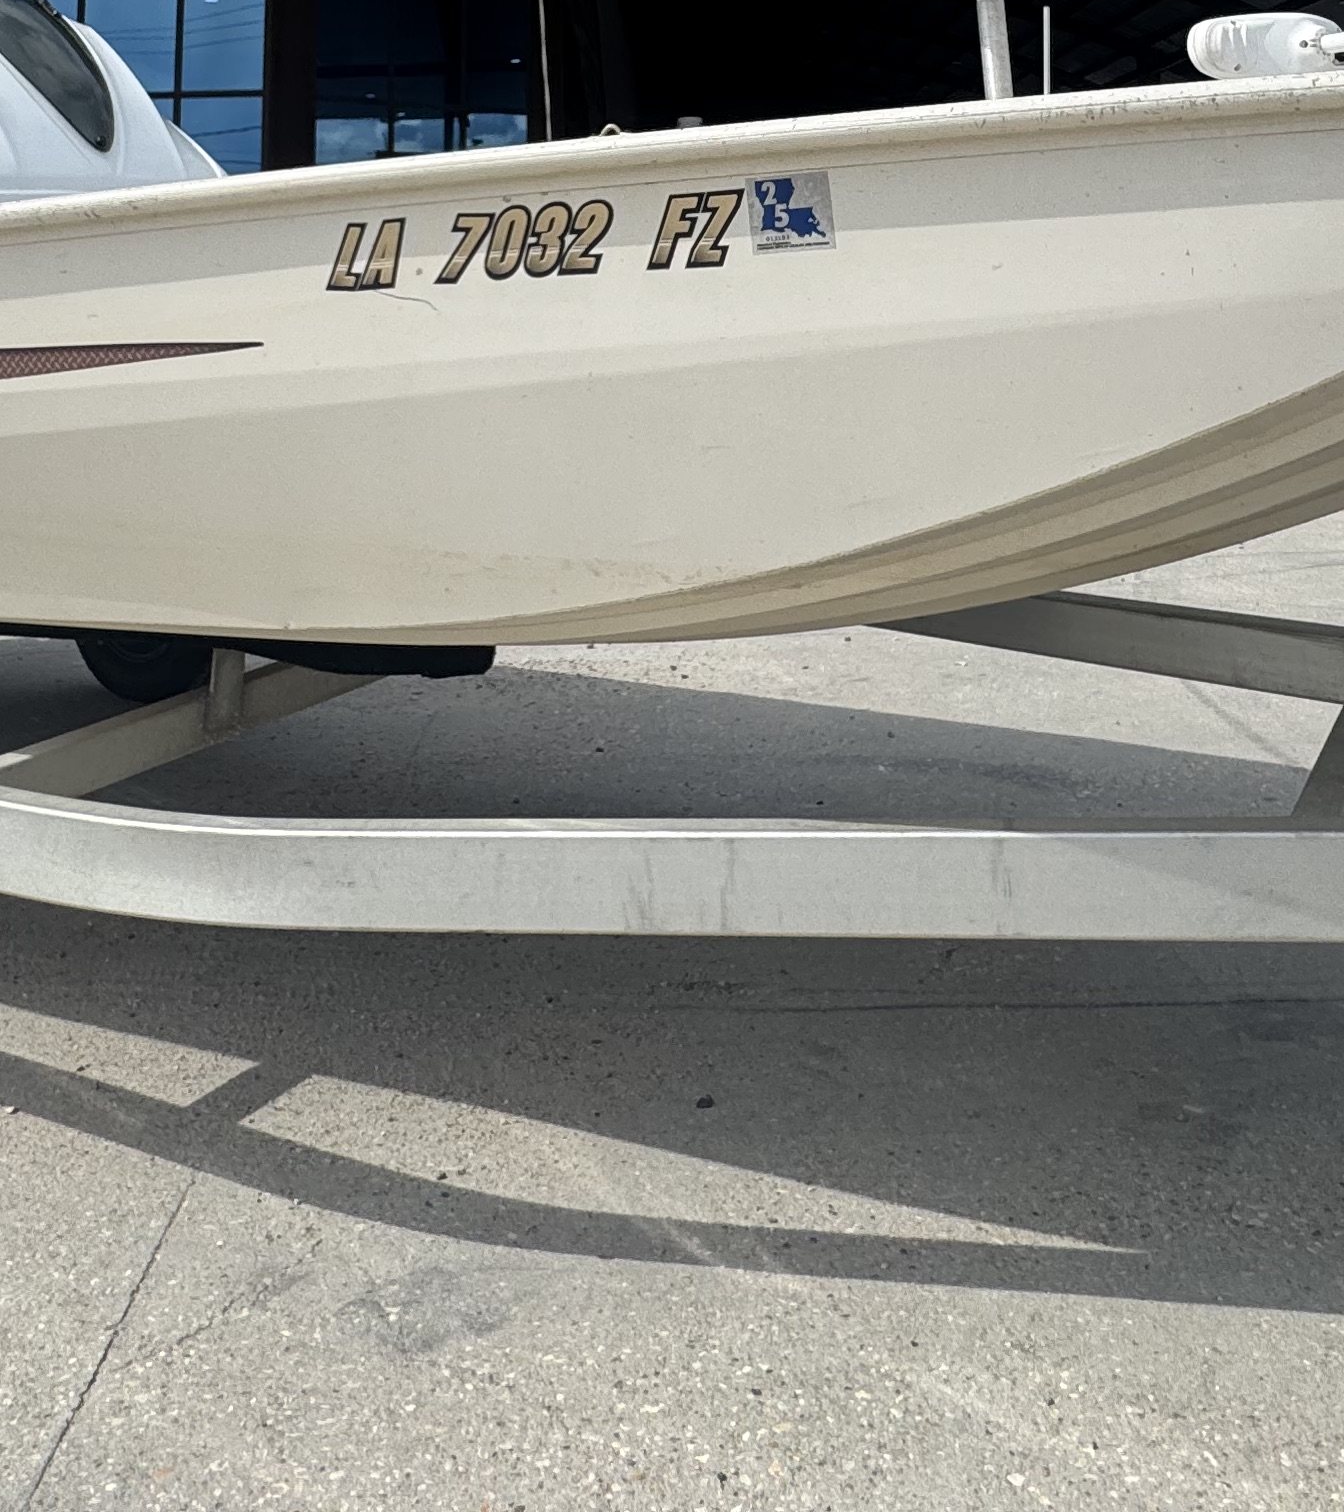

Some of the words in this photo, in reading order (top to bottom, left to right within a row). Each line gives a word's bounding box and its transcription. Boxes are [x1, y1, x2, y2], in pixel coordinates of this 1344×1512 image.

[326, 217, 407, 291] LA
[434, 199, 614, 285] 7032
[647, 189, 745, 270] FZ
